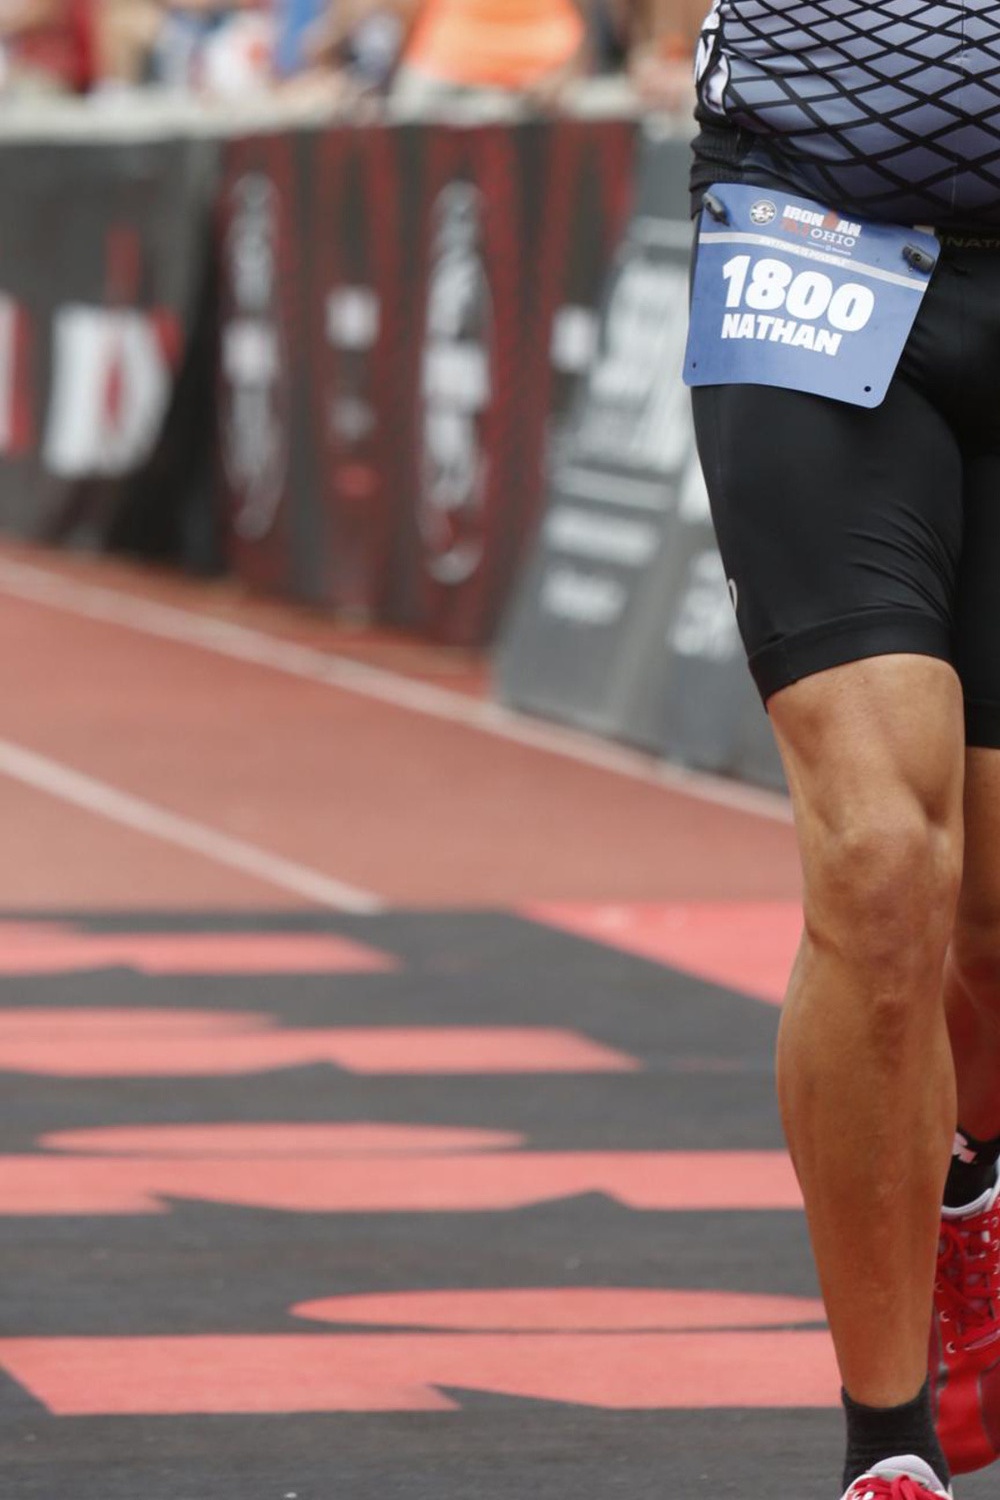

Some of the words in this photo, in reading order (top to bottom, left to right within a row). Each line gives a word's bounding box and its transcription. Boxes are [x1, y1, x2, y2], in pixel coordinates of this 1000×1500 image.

[810, 229, 856, 247] OHIO
[722, 255, 875, 332] 1800
[721, 313, 843, 356] NATHAN
